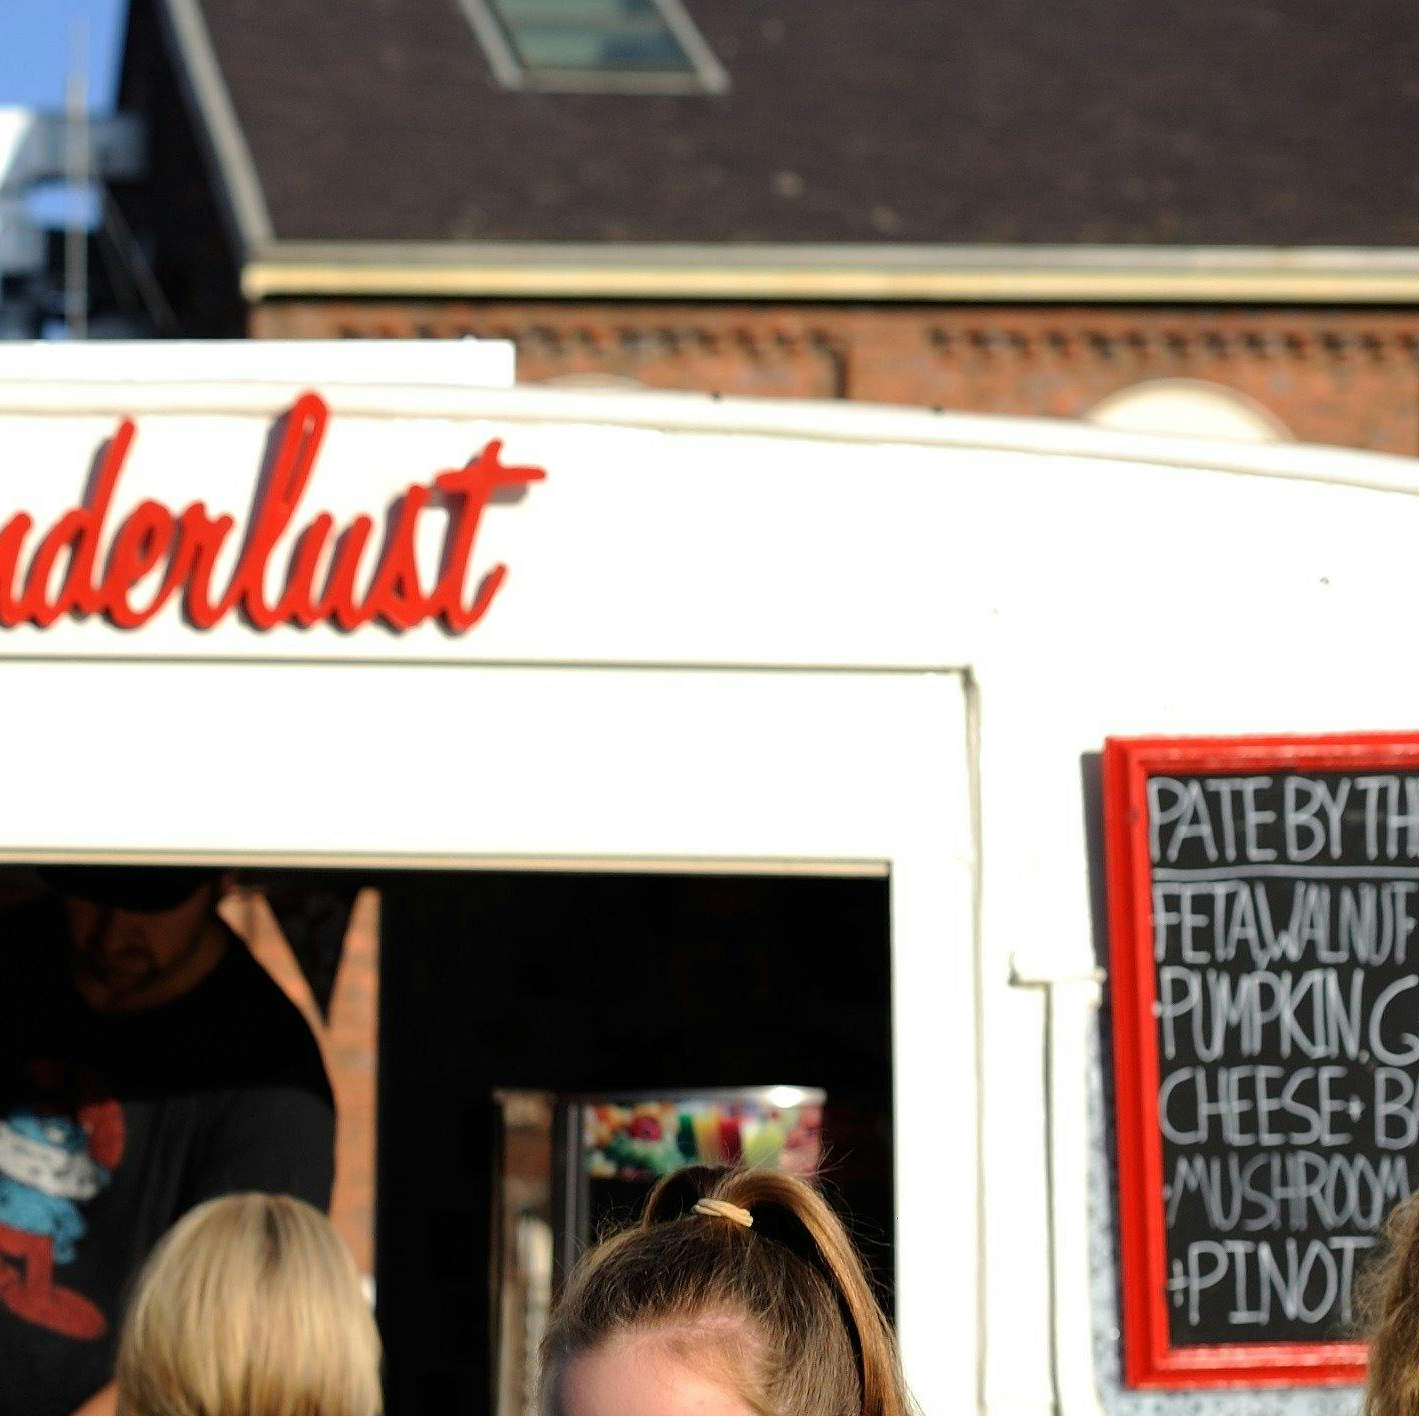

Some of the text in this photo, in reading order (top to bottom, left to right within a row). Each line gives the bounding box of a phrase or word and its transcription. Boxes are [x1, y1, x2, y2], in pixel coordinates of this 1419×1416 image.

[1148, 774, 1419, 862] PATE BY TH
[1152, 879, 1269, 968] FETA
[1158, 1064, 1354, 1148] CHEESE
[1188, 1235, 1379, 1327] PINOT
